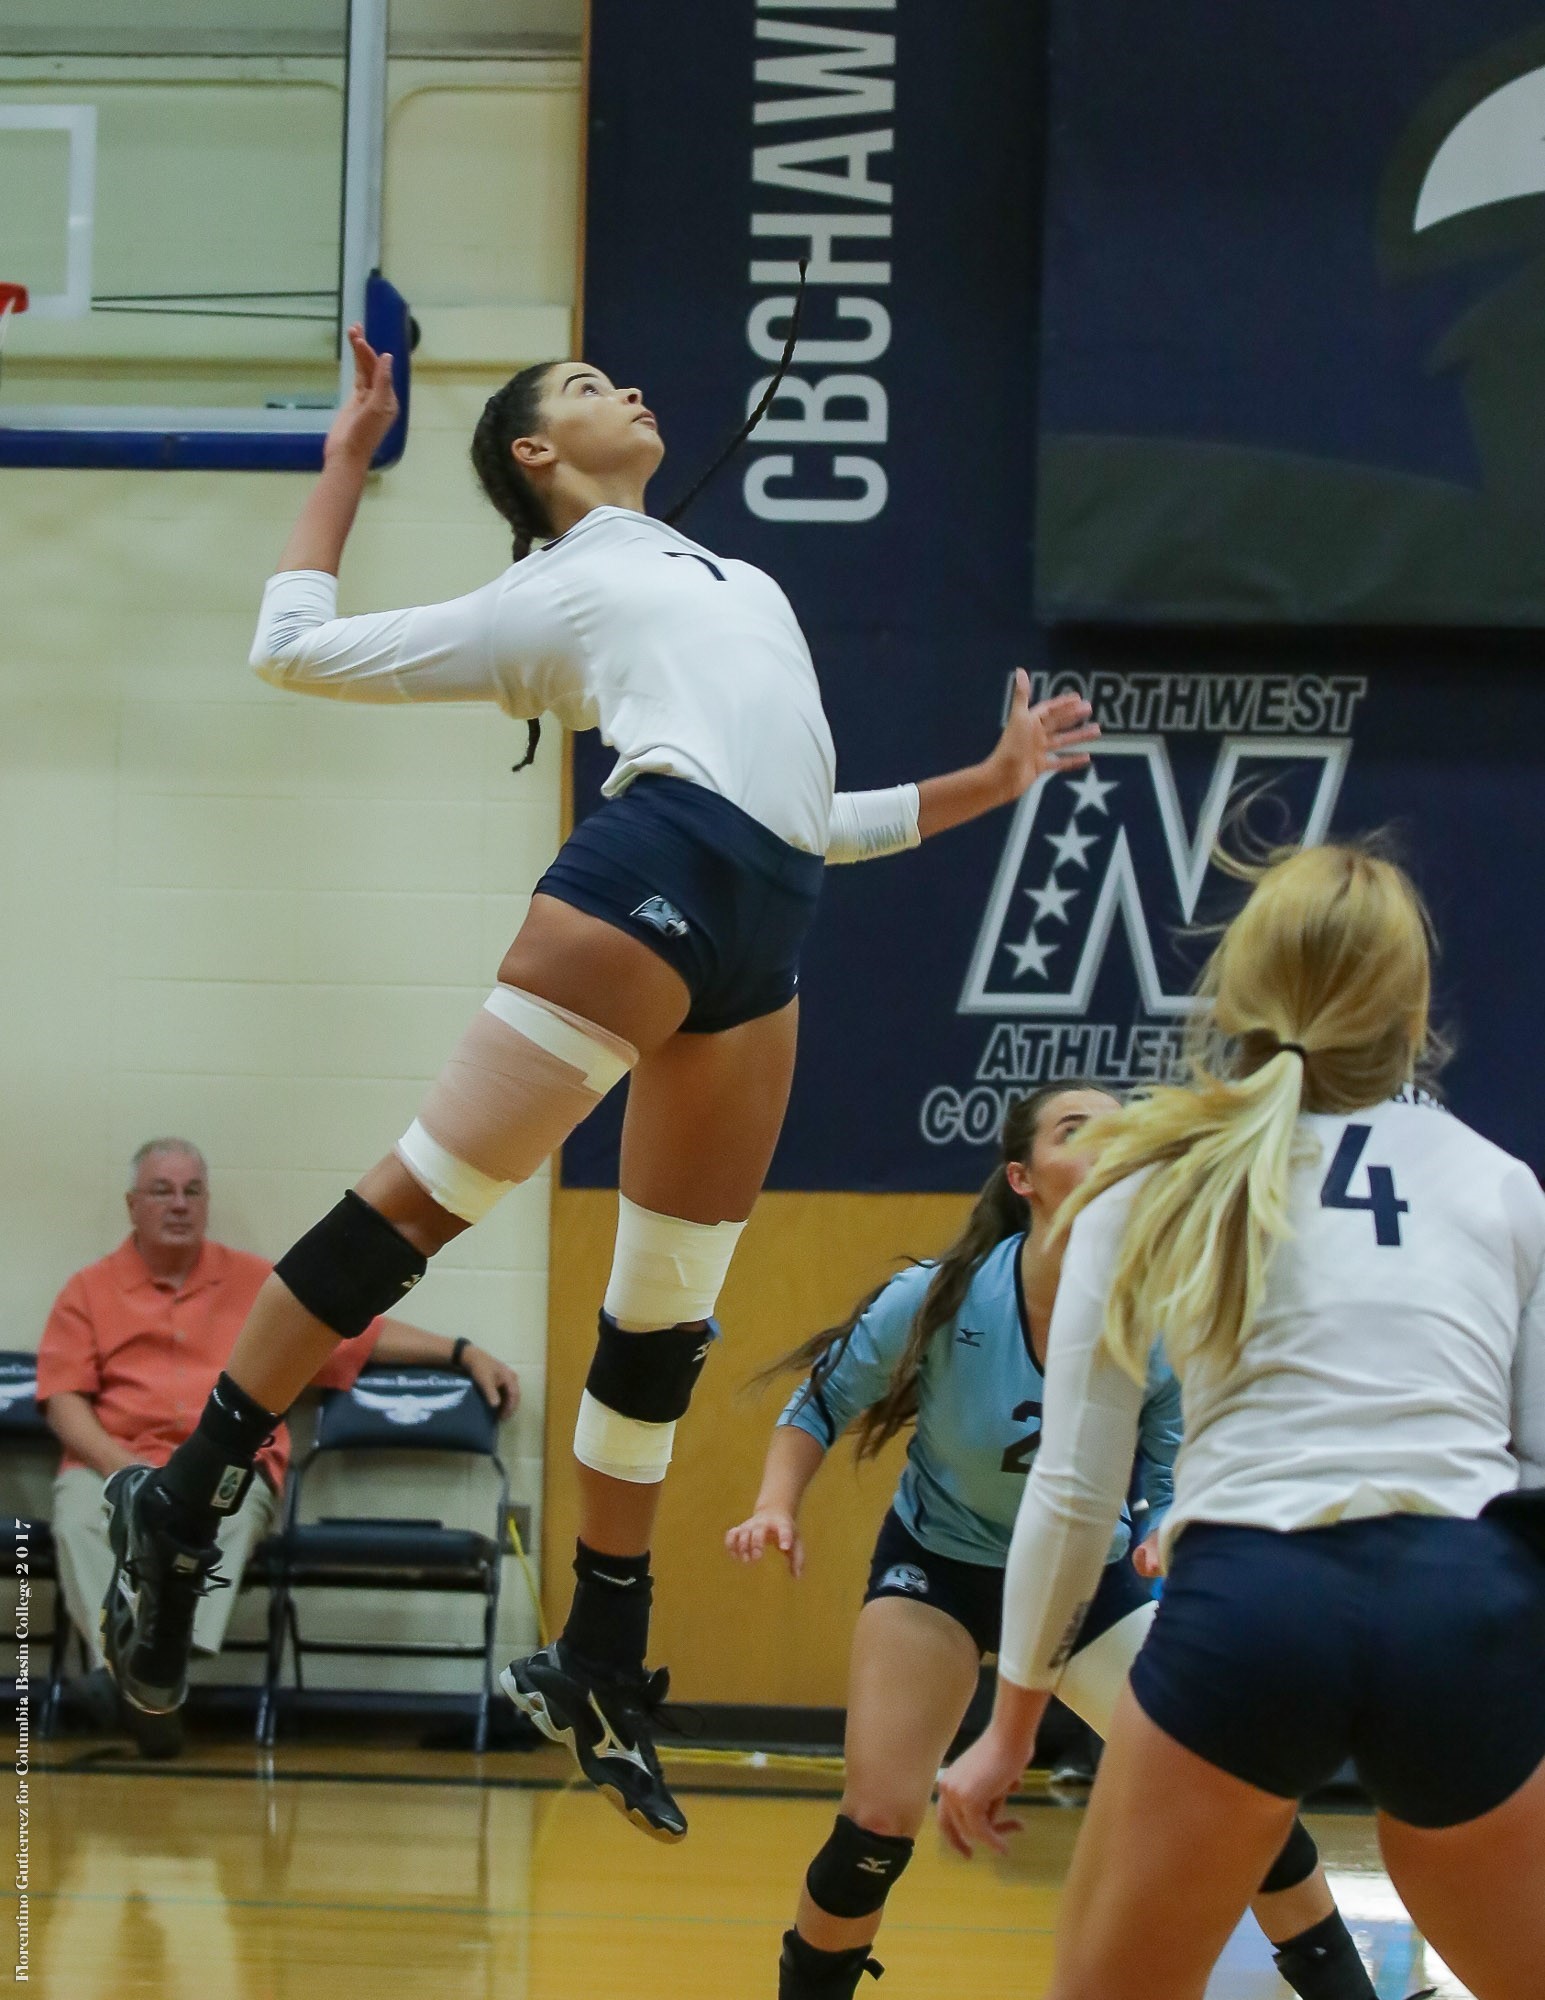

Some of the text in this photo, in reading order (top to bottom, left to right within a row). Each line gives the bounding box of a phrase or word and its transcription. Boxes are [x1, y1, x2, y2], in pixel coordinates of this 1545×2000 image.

[742, 0, 898, 522] CBCHAW
[976, 1022, 1244, 1082] ATHLET
[1320, 1123, 1409, 1246] 4
